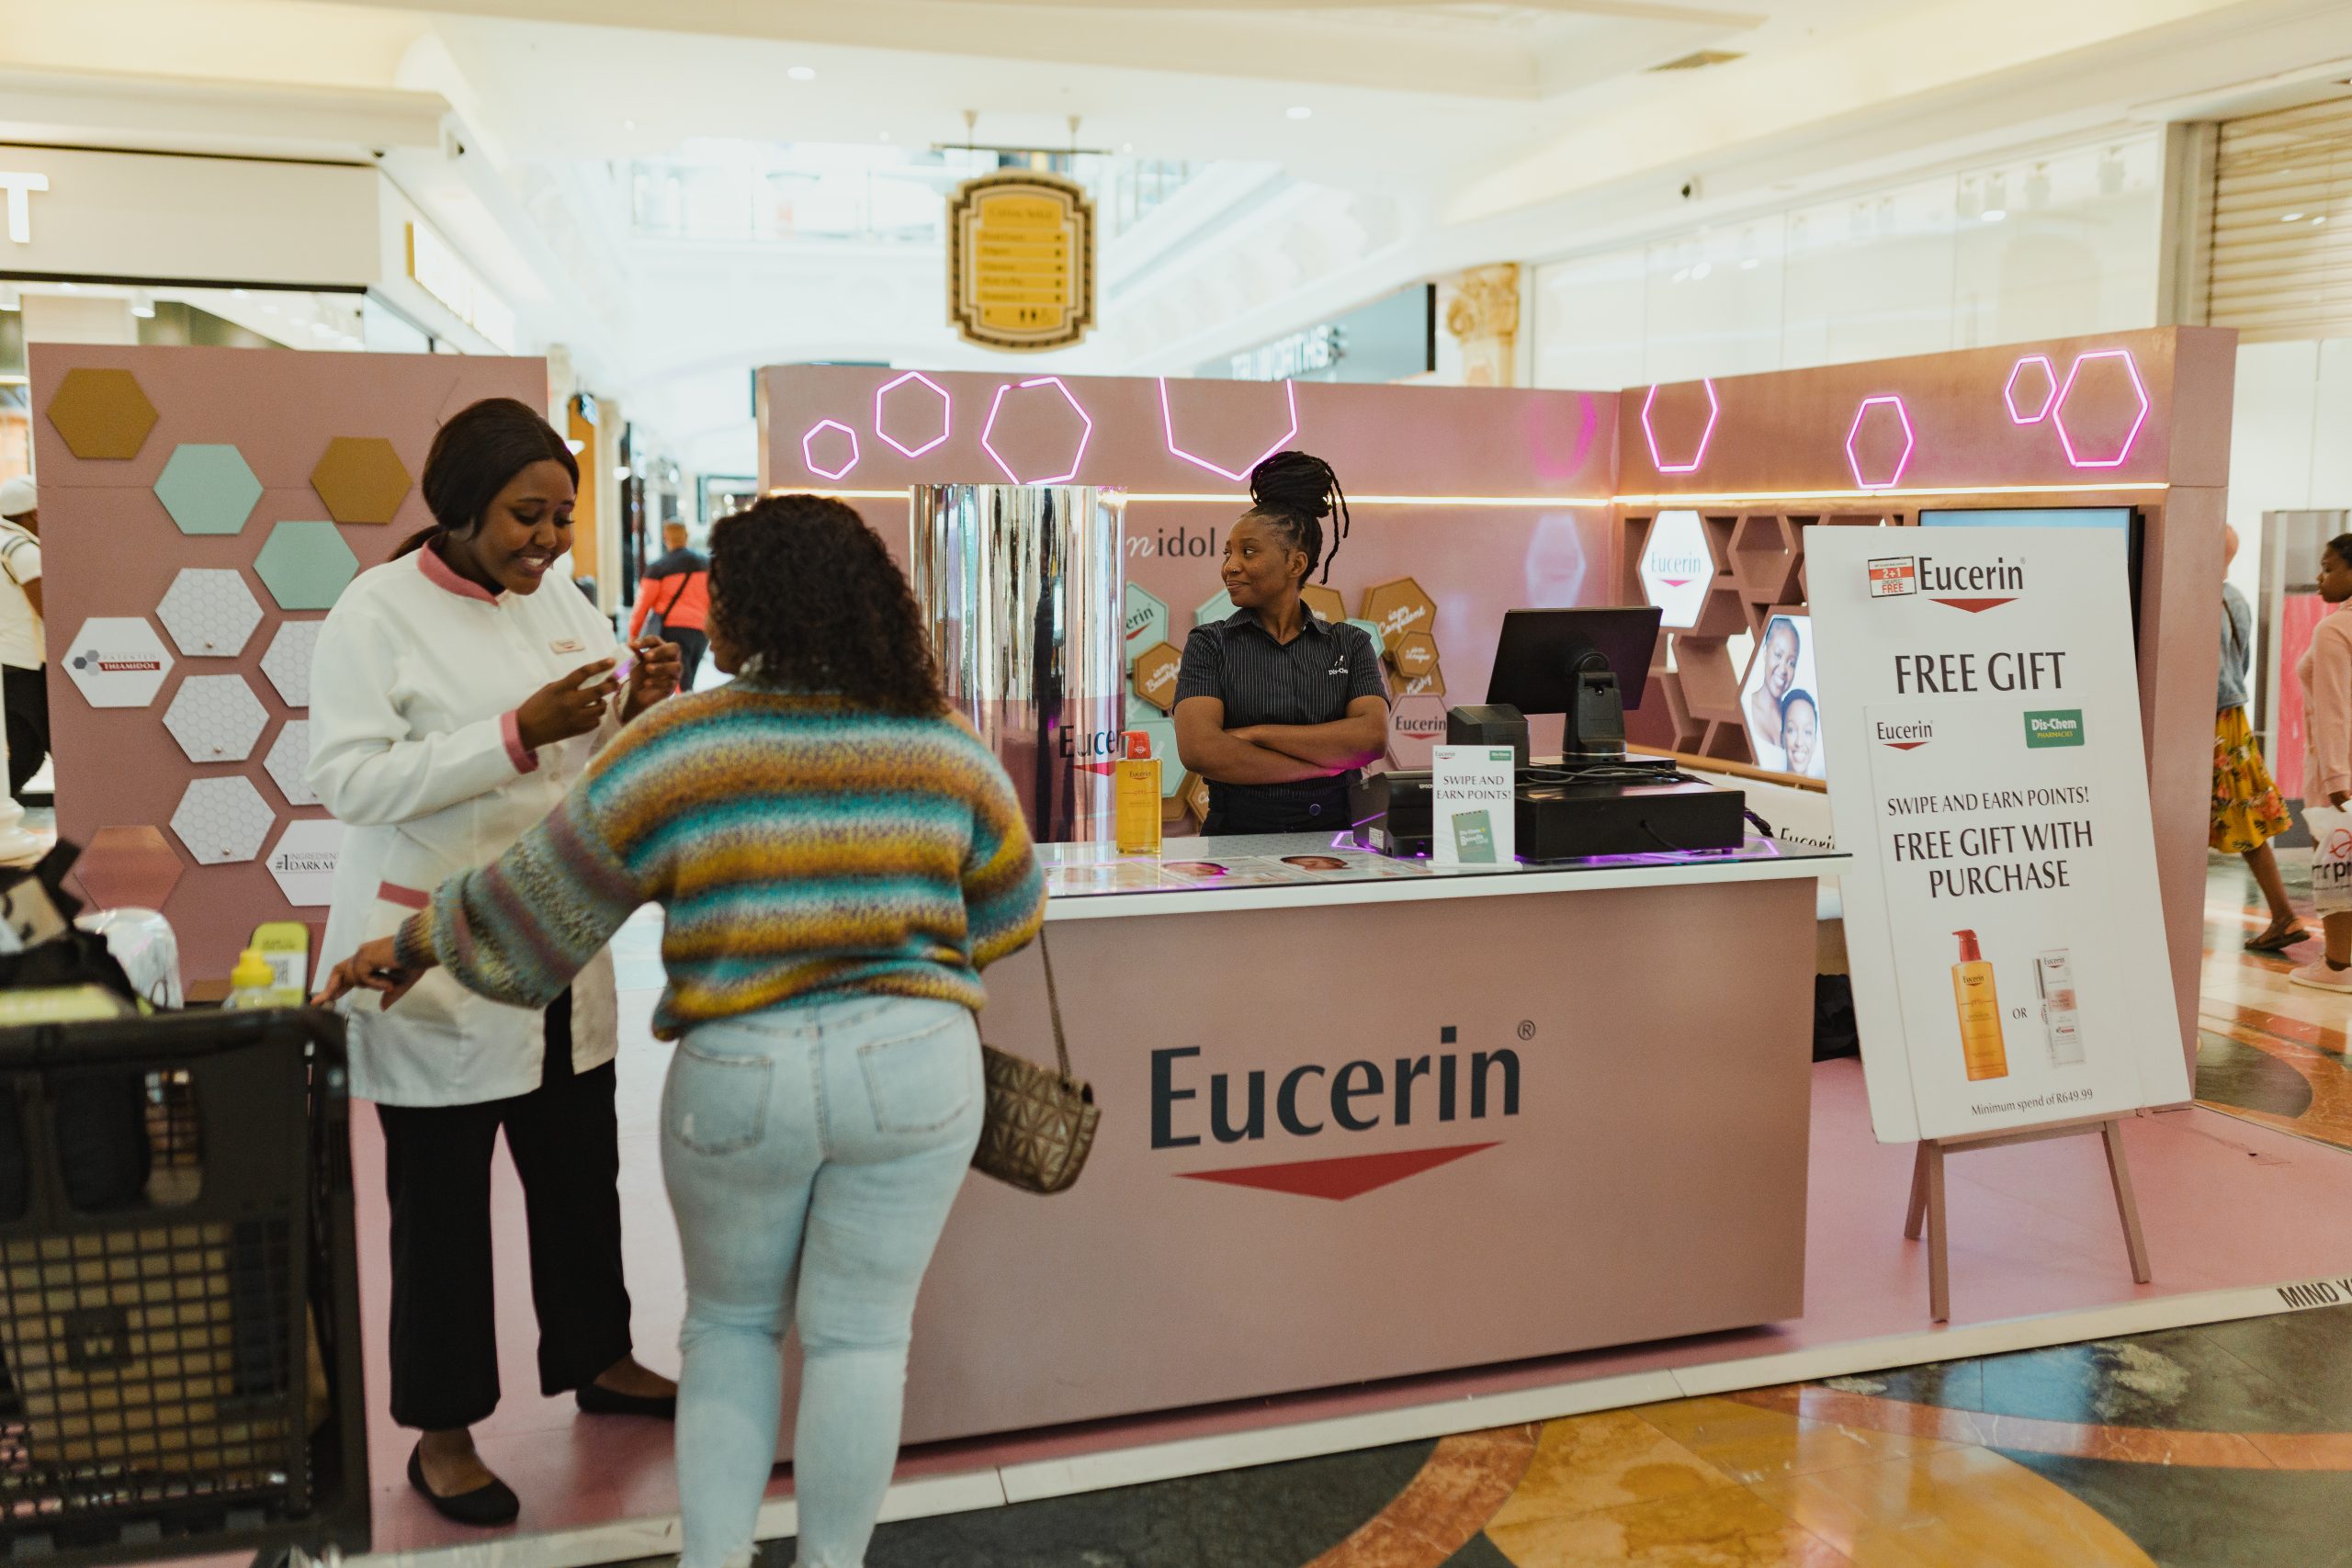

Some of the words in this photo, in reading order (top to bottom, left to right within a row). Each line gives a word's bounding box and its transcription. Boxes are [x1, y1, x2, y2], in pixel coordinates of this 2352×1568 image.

[1651, 551, 1701, 573] Eucerin
[1883, 567, 1901, 579] 2+1
[1919, 557, 2024, 591] Eucerin
[1882, 582, 1904, 593] FREE
[1894, 653, 1978, 694] FREE
[1987, 651, 2066, 691] GIFT
[1877, 720, 1933, 740] Eucerin
[2030, 717, 2077, 731] Dis-Chem
[1443, 775, 1476, 785] SWIPE
[1479, 775, 1504, 785] AND
[1437, 790, 1464, 799] EARN
[1467, 790, 1511, 800] POINTS!
[1887, 795, 1939, 816] SWIPE
[1942, 793, 1978, 812] AND
[1983, 790, 2023, 809] EARN
[2028, 786, 2089, 807] POINTS!
[1894, 830, 1953, 862] FREE
[1960, 826, 2016, 856] GIFT
[2021, 820, 2093, 852] WITH
[276, 854, 288, 871] #1
[290, 861, 321, 870] DARK
[1929, 860, 2070, 898] PURCHASE
[1962, 974, 1984, 983] Eucerin
[2012, 1007, 2029, 1020] OR
[1971, 1101, 2016, 1117] Minimum
[2017, 1096, 2044, 1112] spend
[2046, 1095, 2057, 1106] of
[2055, 1089, 2094, 1103] R649.99
[2277, 1281, 2340, 1308] MIND
[2336, 1278, 2352, 1297] Y
